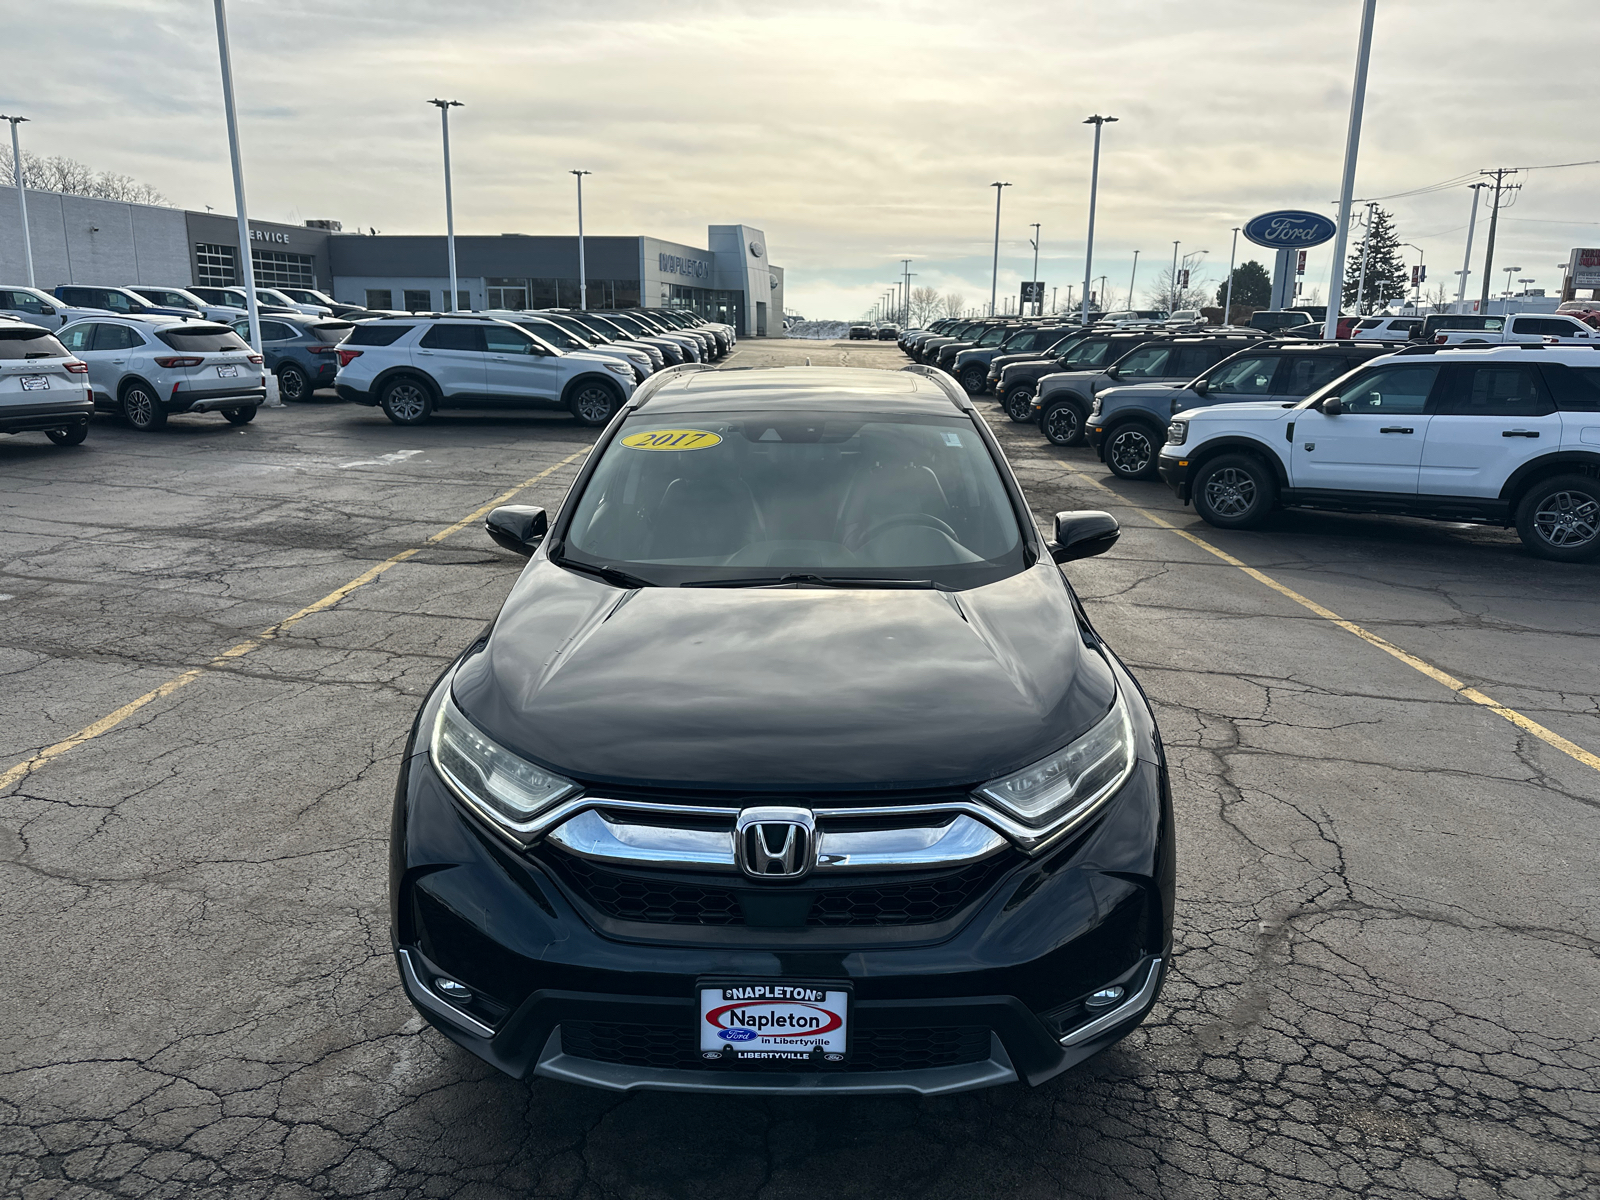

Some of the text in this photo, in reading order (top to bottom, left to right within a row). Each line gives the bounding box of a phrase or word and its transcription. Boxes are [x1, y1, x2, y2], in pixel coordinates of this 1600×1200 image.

[1264, 217, 1319, 240] Ford
[249, 229, 290, 244] ERVICE
[659, 252, 709, 279] NAPLETON
[633, 433, 708, 447] 2017
[732, 986, 817, 1001] NAPLETON
[730, 1010, 820, 1031] Napleton
[726, 1030, 750, 1040] Ford
[773, 1037, 830, 1047] Libertyville
[738, 1052, 810, 1060] LIBERTYVILLE
